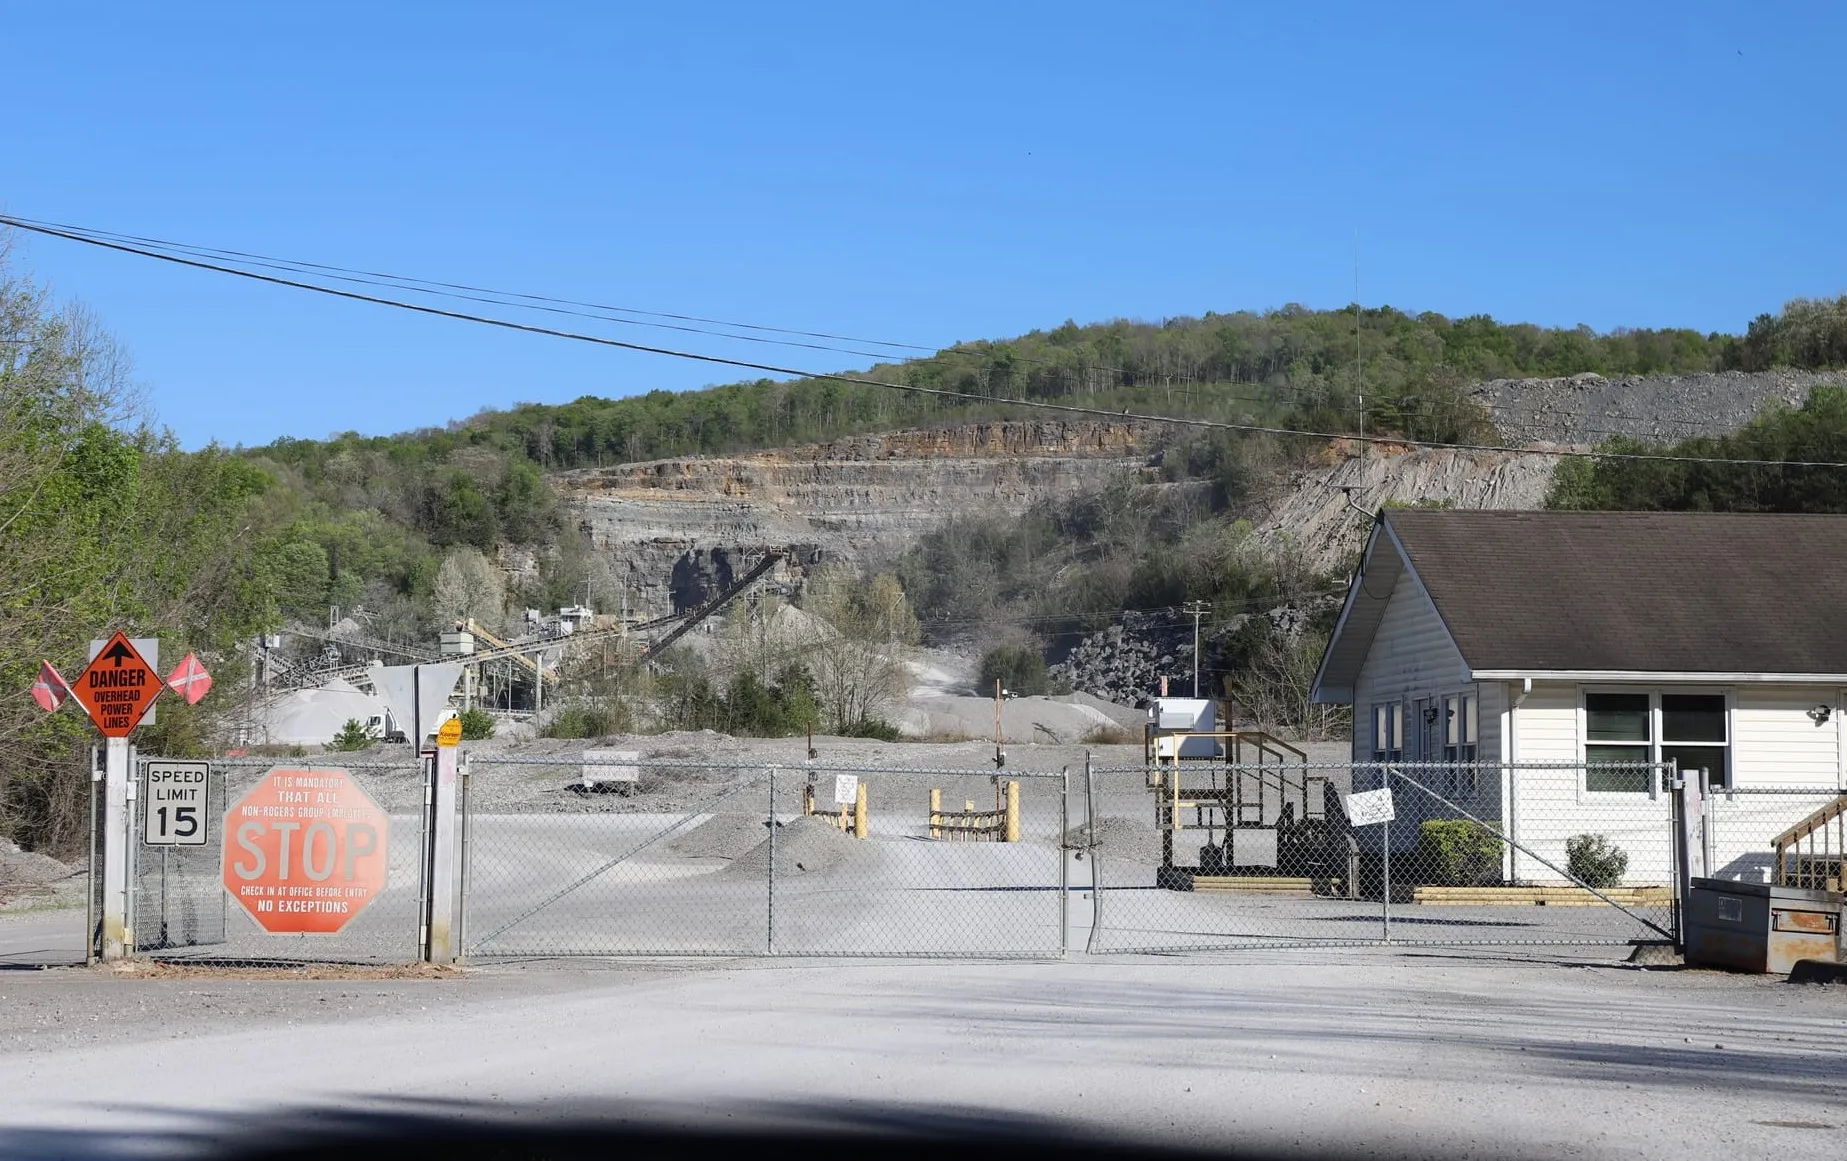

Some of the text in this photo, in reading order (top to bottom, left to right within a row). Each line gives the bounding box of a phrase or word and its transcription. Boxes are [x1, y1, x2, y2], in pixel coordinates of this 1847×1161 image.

[90, 669, 146, 688] DANGER
[94, 690, 140, 703] OVERHEAD
[101, 703, 133, 715] POWER
[104, 717, 129, 728] LINES
[151, 770, 204, 783] SPEED
[273, 776, 343, 789] IT IS MANDATORY
[157, 789, 198, 800] LIMIT
[278, 790, 338, 803] THAT ALL
[242, 805, 294, 818] NON-ROGERS
[298, 806, 324, 819] GROUP
[157, 807, 198, 837] 15
[233, 821, 377, 882] STOP
[240, 885, 368, 898] CHECK IN AT OFFICE BEFORE ENTRY
[257, 900, 348, 913] NO EXCEPTIONS
